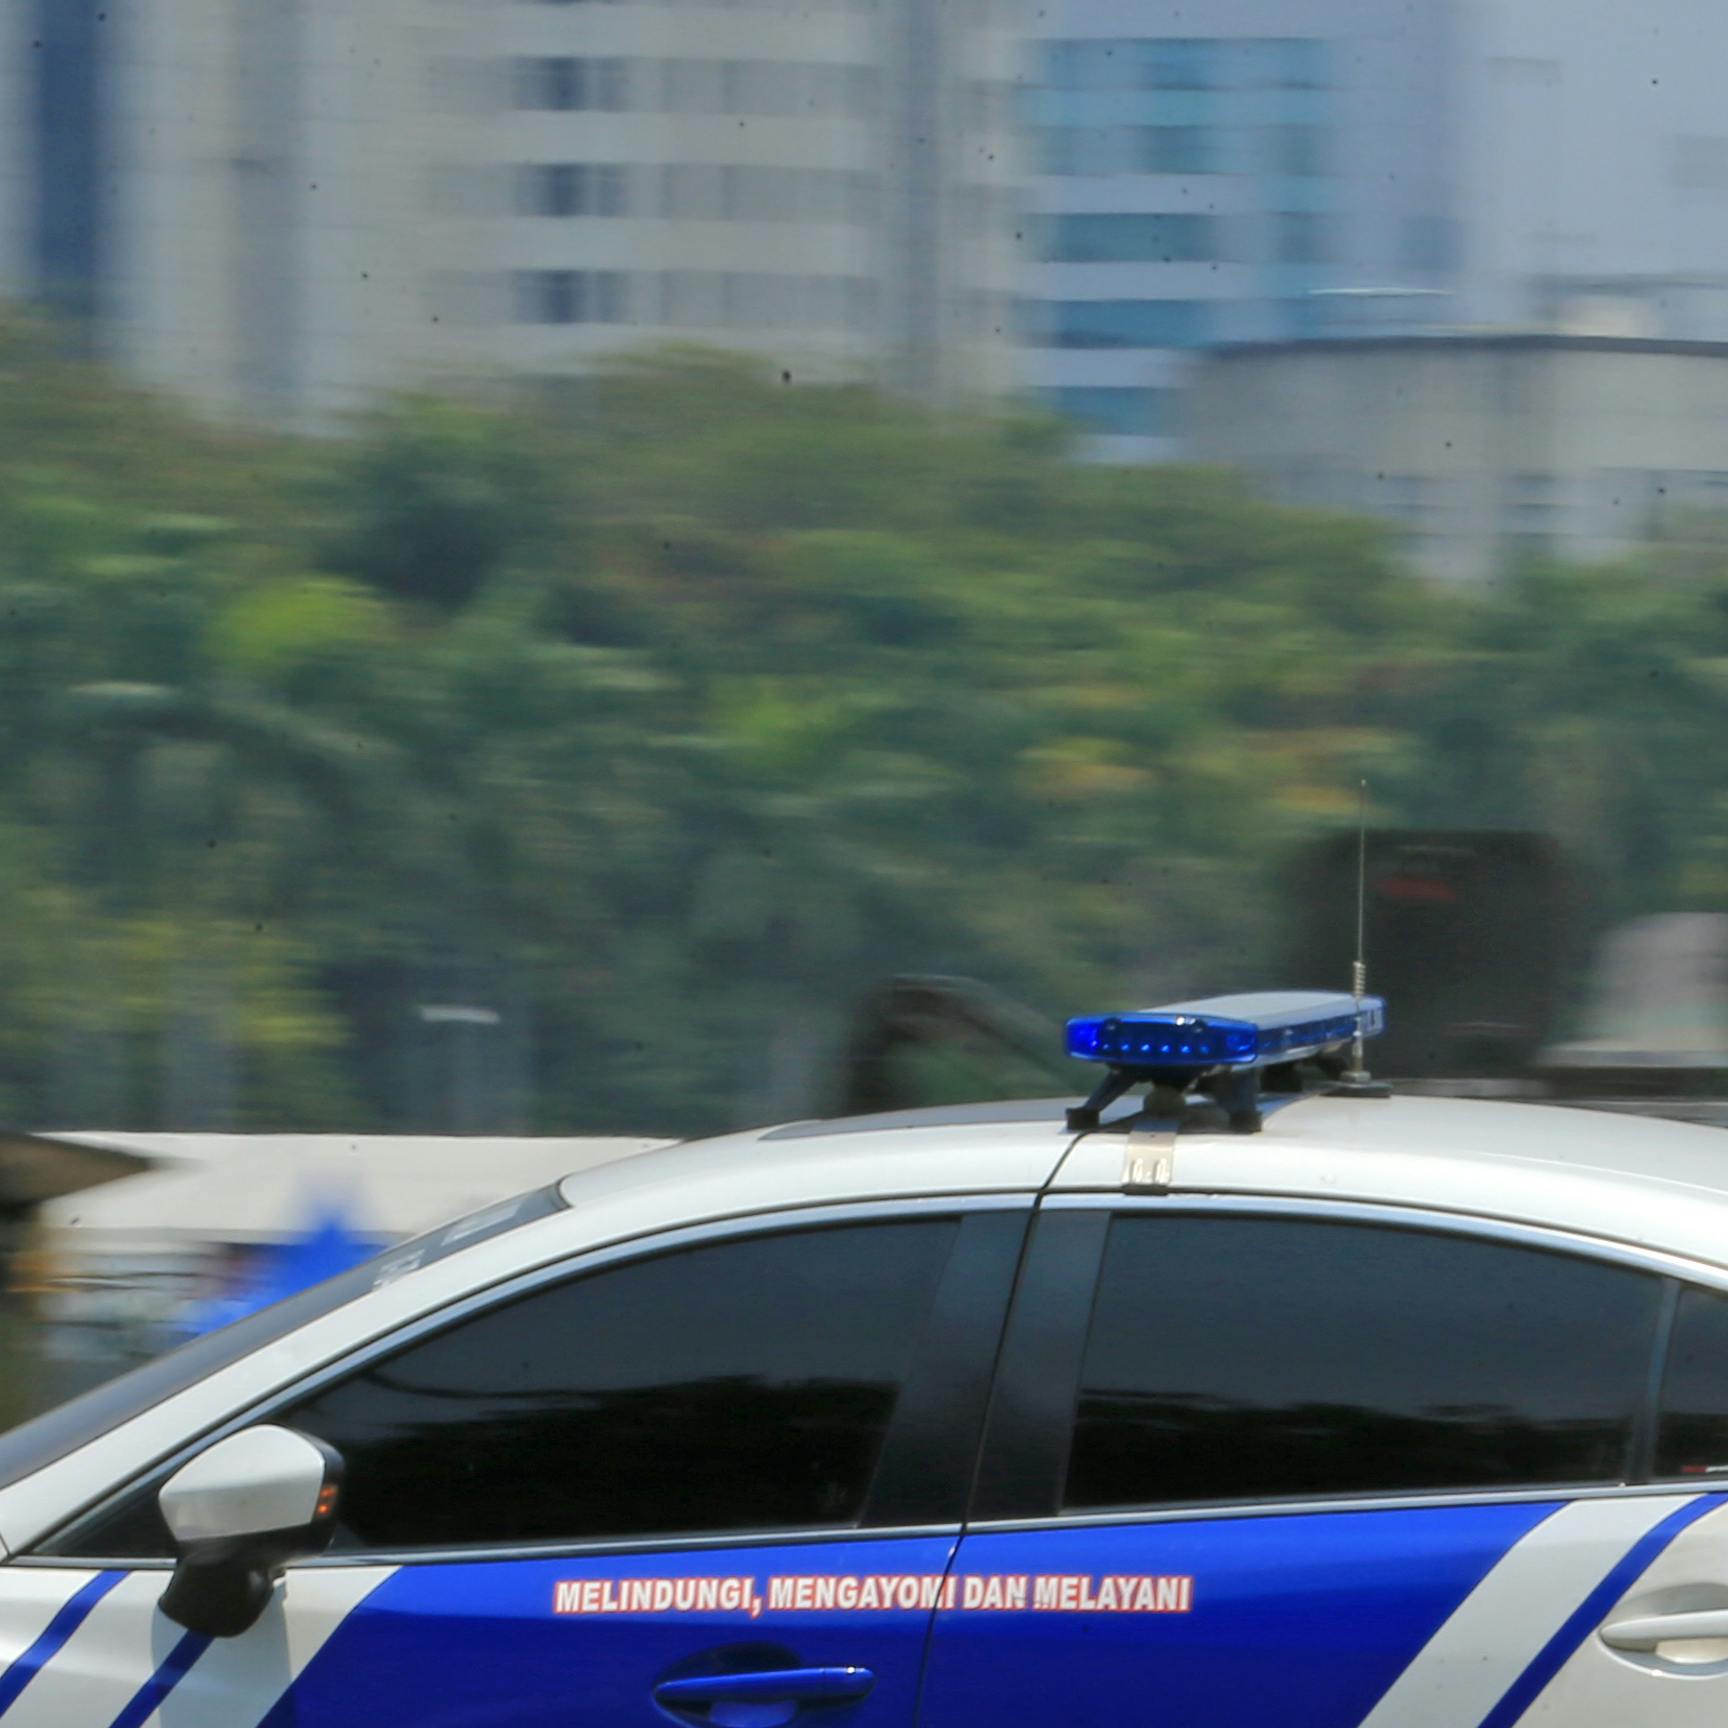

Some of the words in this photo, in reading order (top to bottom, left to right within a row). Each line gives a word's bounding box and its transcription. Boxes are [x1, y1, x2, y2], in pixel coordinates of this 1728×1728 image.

[554, 1577, 763, 1617] MELINDUNGI,
[768, 1576, 956, 1612] MENGAYOMI
[962, 1576, 1027, 1611] DAN
[1032, 1576, 1194, 1613] MELAYANI
